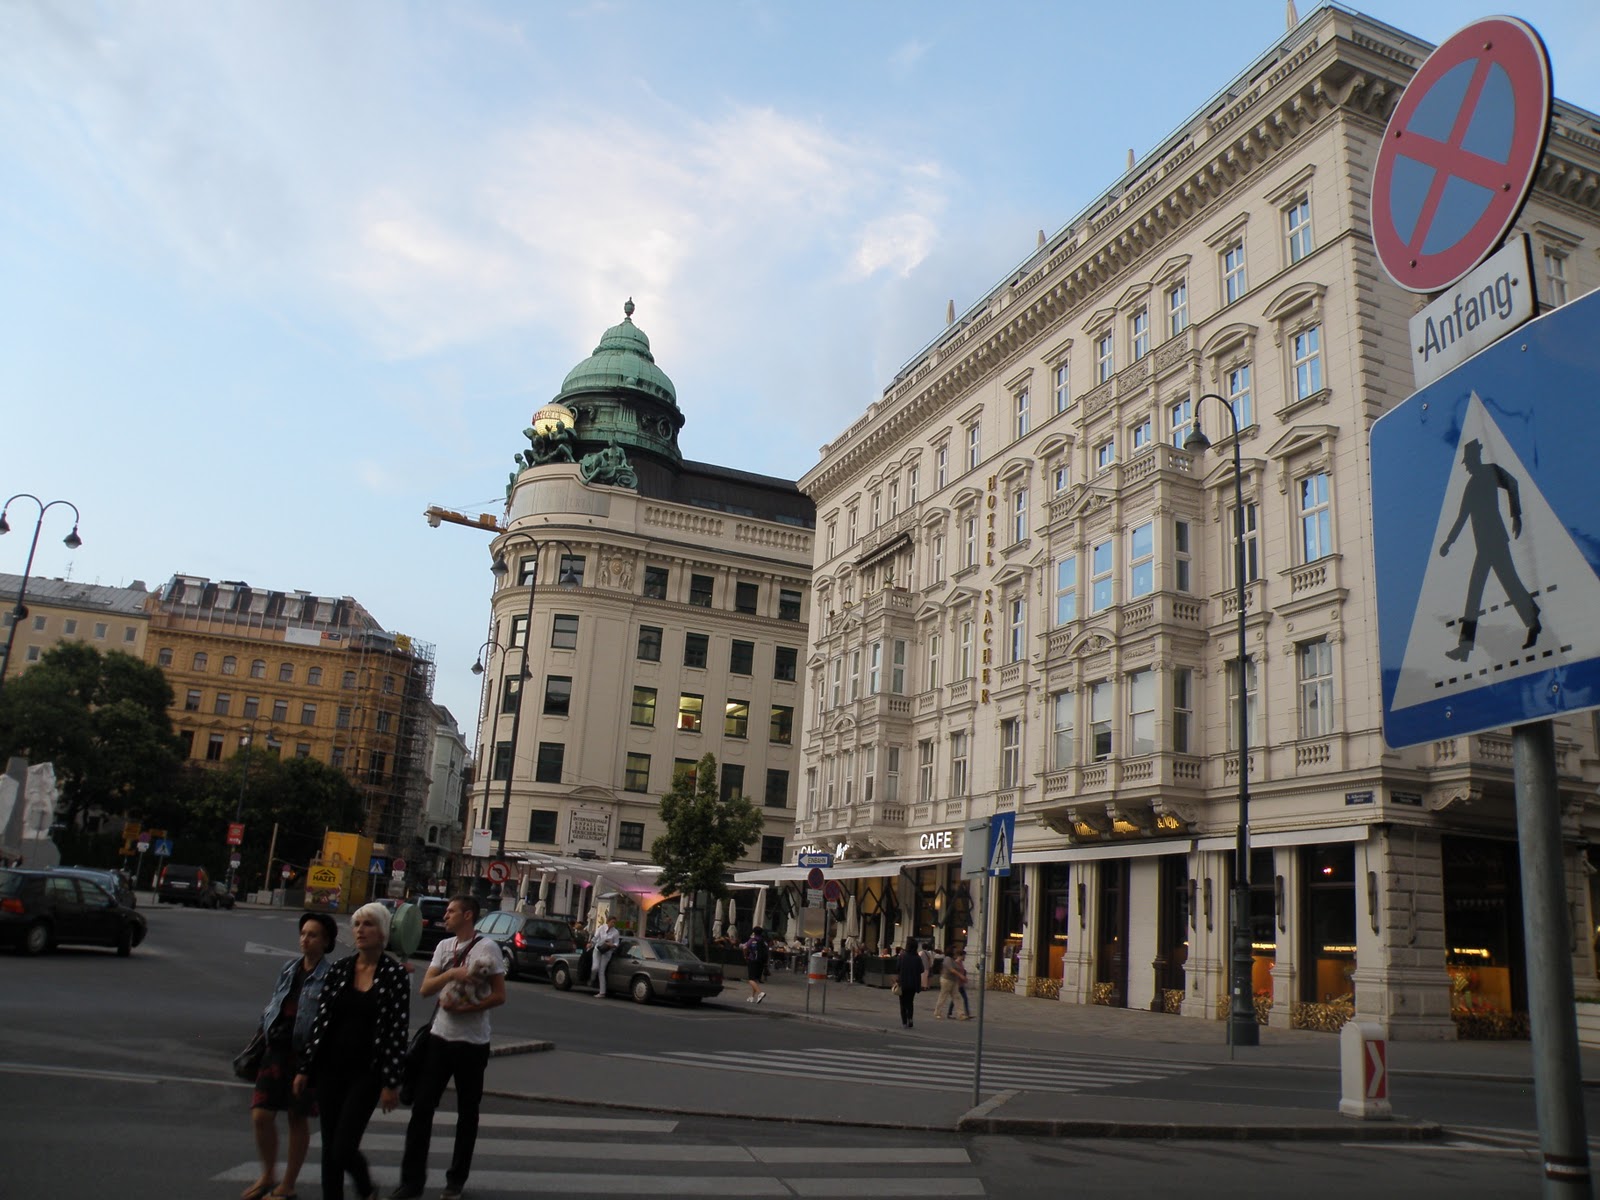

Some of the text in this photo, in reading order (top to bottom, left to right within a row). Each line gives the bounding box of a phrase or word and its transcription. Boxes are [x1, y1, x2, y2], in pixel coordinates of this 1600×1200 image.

[1424, 272, 1513, 362] Anfang
[981, 475, 997, 705] HOTEL SACHER
[920, 831, 952, 850] CAFE
